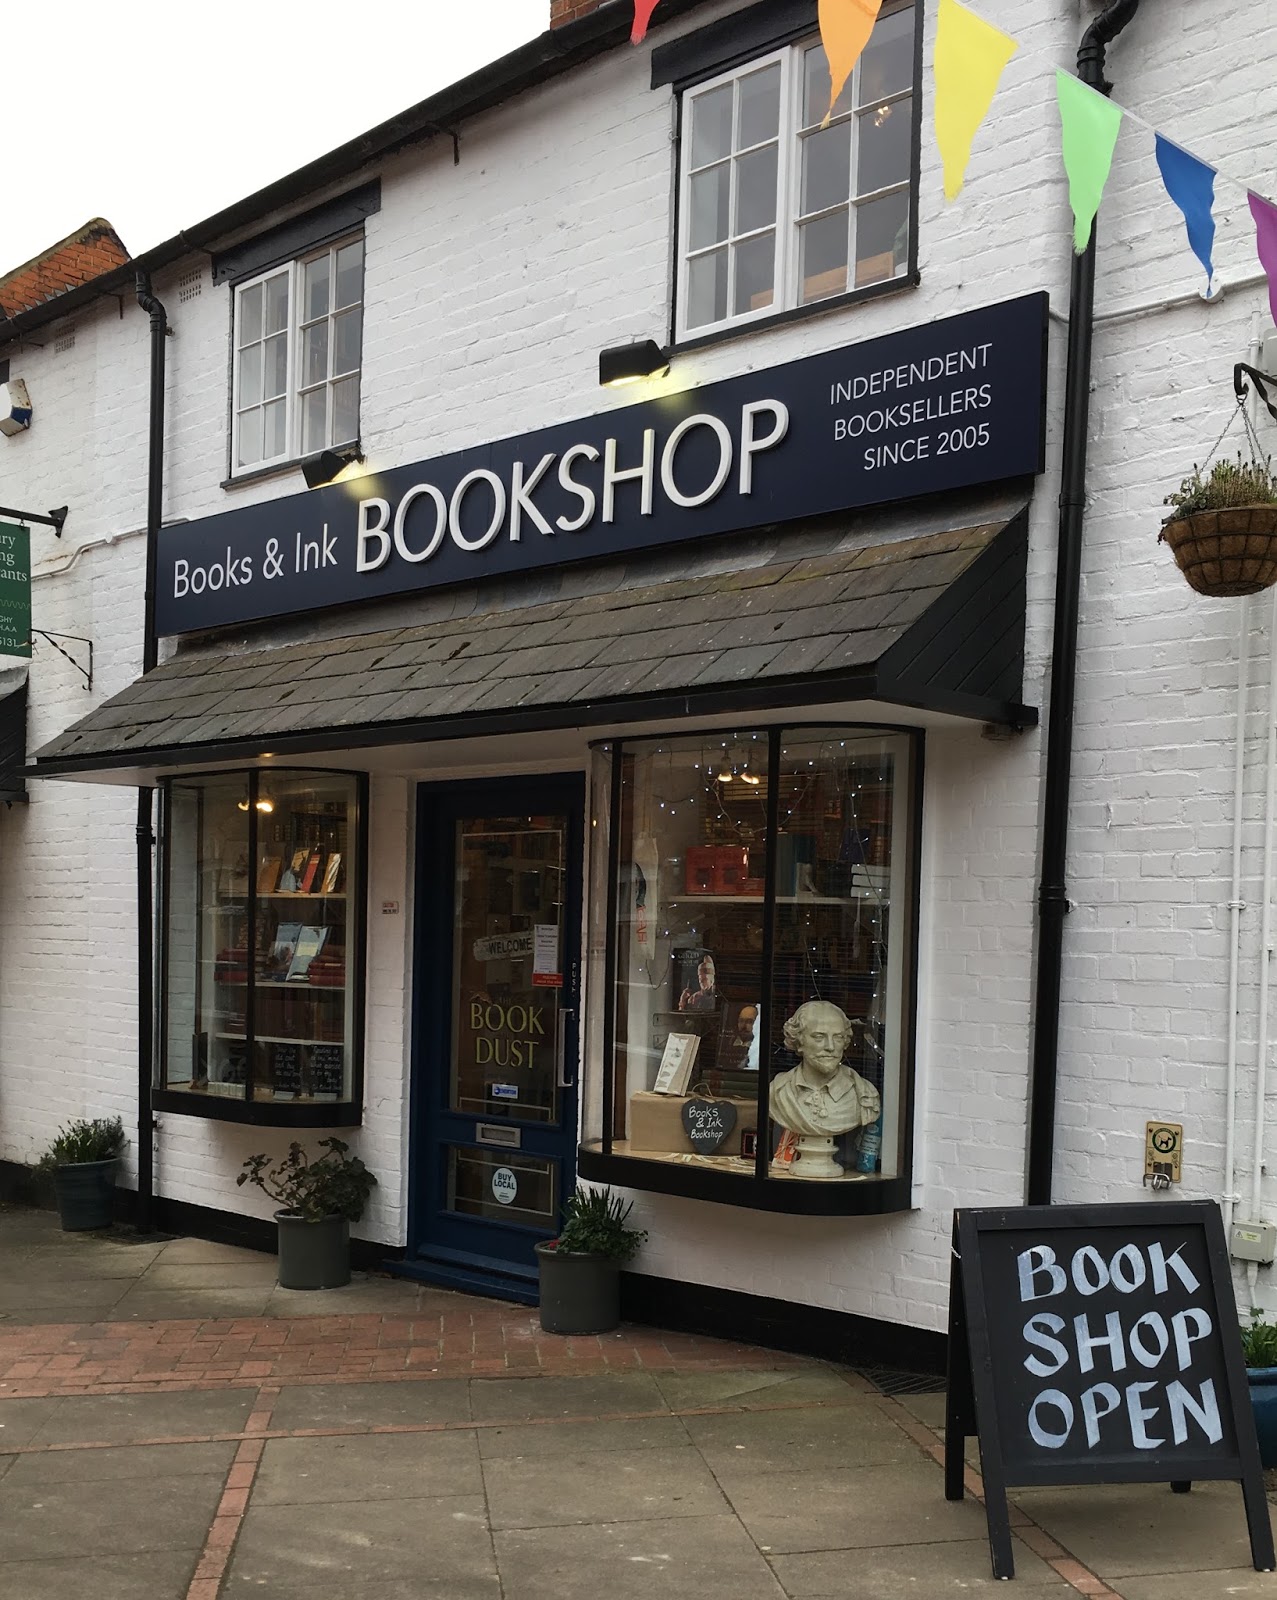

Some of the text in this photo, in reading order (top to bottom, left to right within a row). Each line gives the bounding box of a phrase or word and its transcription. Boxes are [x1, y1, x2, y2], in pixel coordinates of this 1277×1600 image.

[830, 342, 993, 405] INDEPENDENT
[834, 383, 992, 441] BOOKSELLERS
[863, 422, 990, 471] SINCE 2005
[173, 398, 790, 599] Books & Ink BOOKSHOP
[0, 535, 16, 549] ry
[0, 569, 28, 582] ants
[488, 937, 533, 955] WELCOME
[470, 1003, 545, 1035] BOOK
[476, 1037, 540, 1068] DUST
[688, 1105, 719, 1118] Books
[695, 1116, 723, 1128] & Ink
[690, 1128, 724, 1144] Bookshop
[493, 1179, 516, 1190] LOCAL
[497, 1172, 512, 1182] BUY
[1017, 1241, 1201, 1302] BOOK
[1022, 1307, 1213, 1378] SHOP
[1027, 1378, 1223, 1449] OPEN
